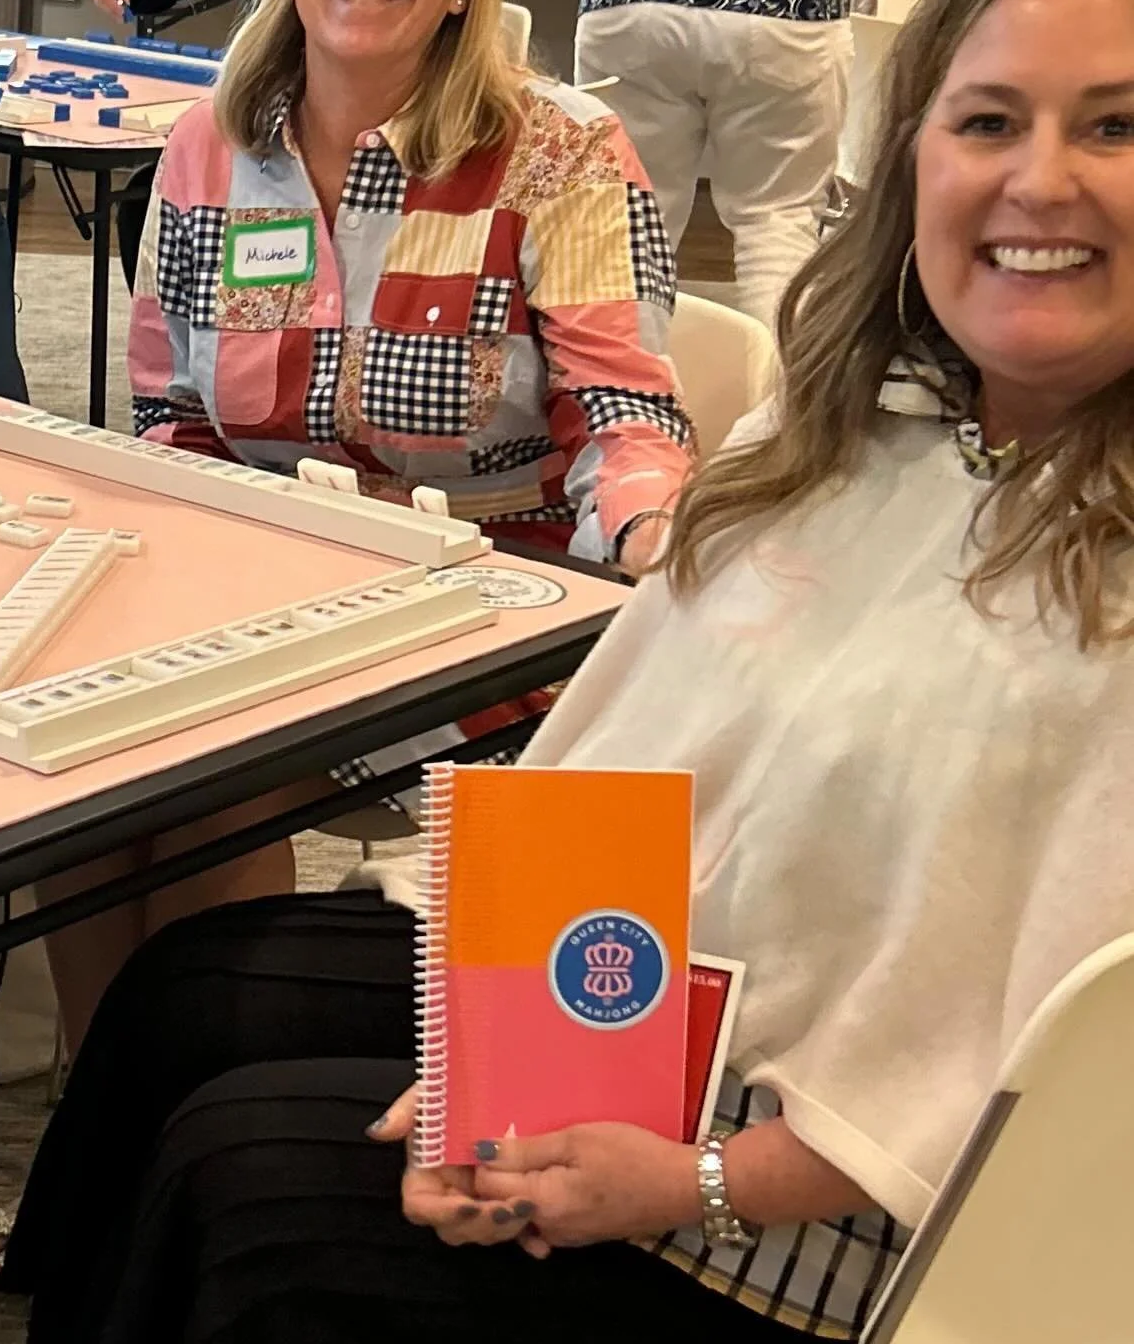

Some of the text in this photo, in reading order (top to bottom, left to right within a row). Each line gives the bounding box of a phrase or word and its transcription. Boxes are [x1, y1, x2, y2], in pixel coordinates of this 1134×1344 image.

[570, 921, 650, 946] QUEEN CITY
[574, 999, 641, 1019] MAHJONG
